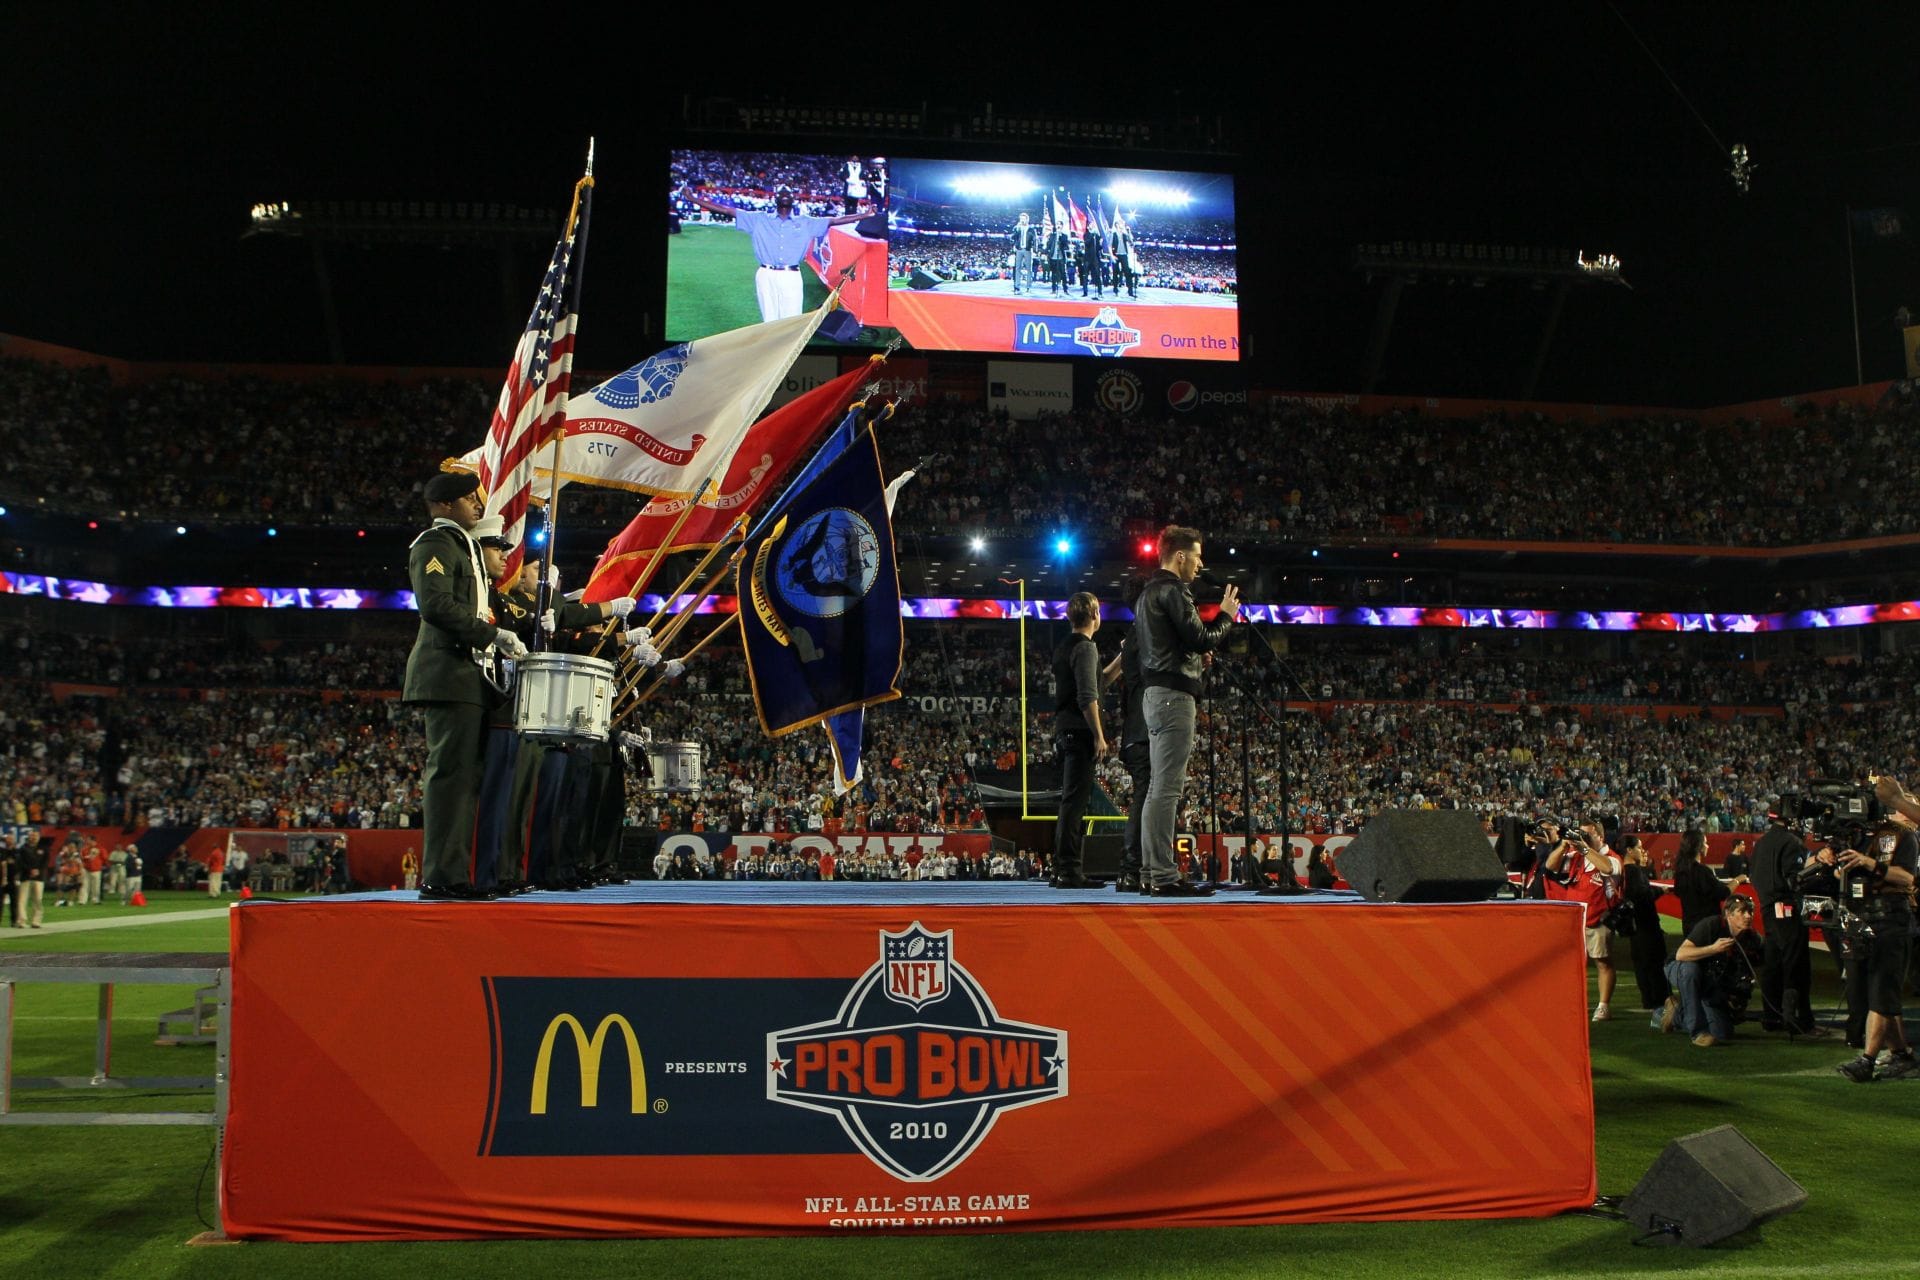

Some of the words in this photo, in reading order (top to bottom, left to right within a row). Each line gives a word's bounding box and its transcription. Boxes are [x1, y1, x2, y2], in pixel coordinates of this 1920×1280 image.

[1081, 330, 1106, 344] PRO
[1161, 334, 1196, 348] Own
[1200, 336, 1227, 349] the
[776, 376, 826, 391] bli
[1201, 390, 1247, 404] pepsi
[754, 543, 770, 577] UNITED
[766, 614, 788, 639] NAVY
[890, 963, 943, 999] NFL
[665, 1062, 748, 1074] PRESENTS
[795, 1035, 906, 1098] PRO
[917, 1031, 1046, 1098] BOWL
[889, 1122, 948, 1139] 2010
[805, 1198, 848, 1213] NFL
[854, 1196, 961, 1212] ALL-STAR
[968, 1194, 1030, 1210] GAME
